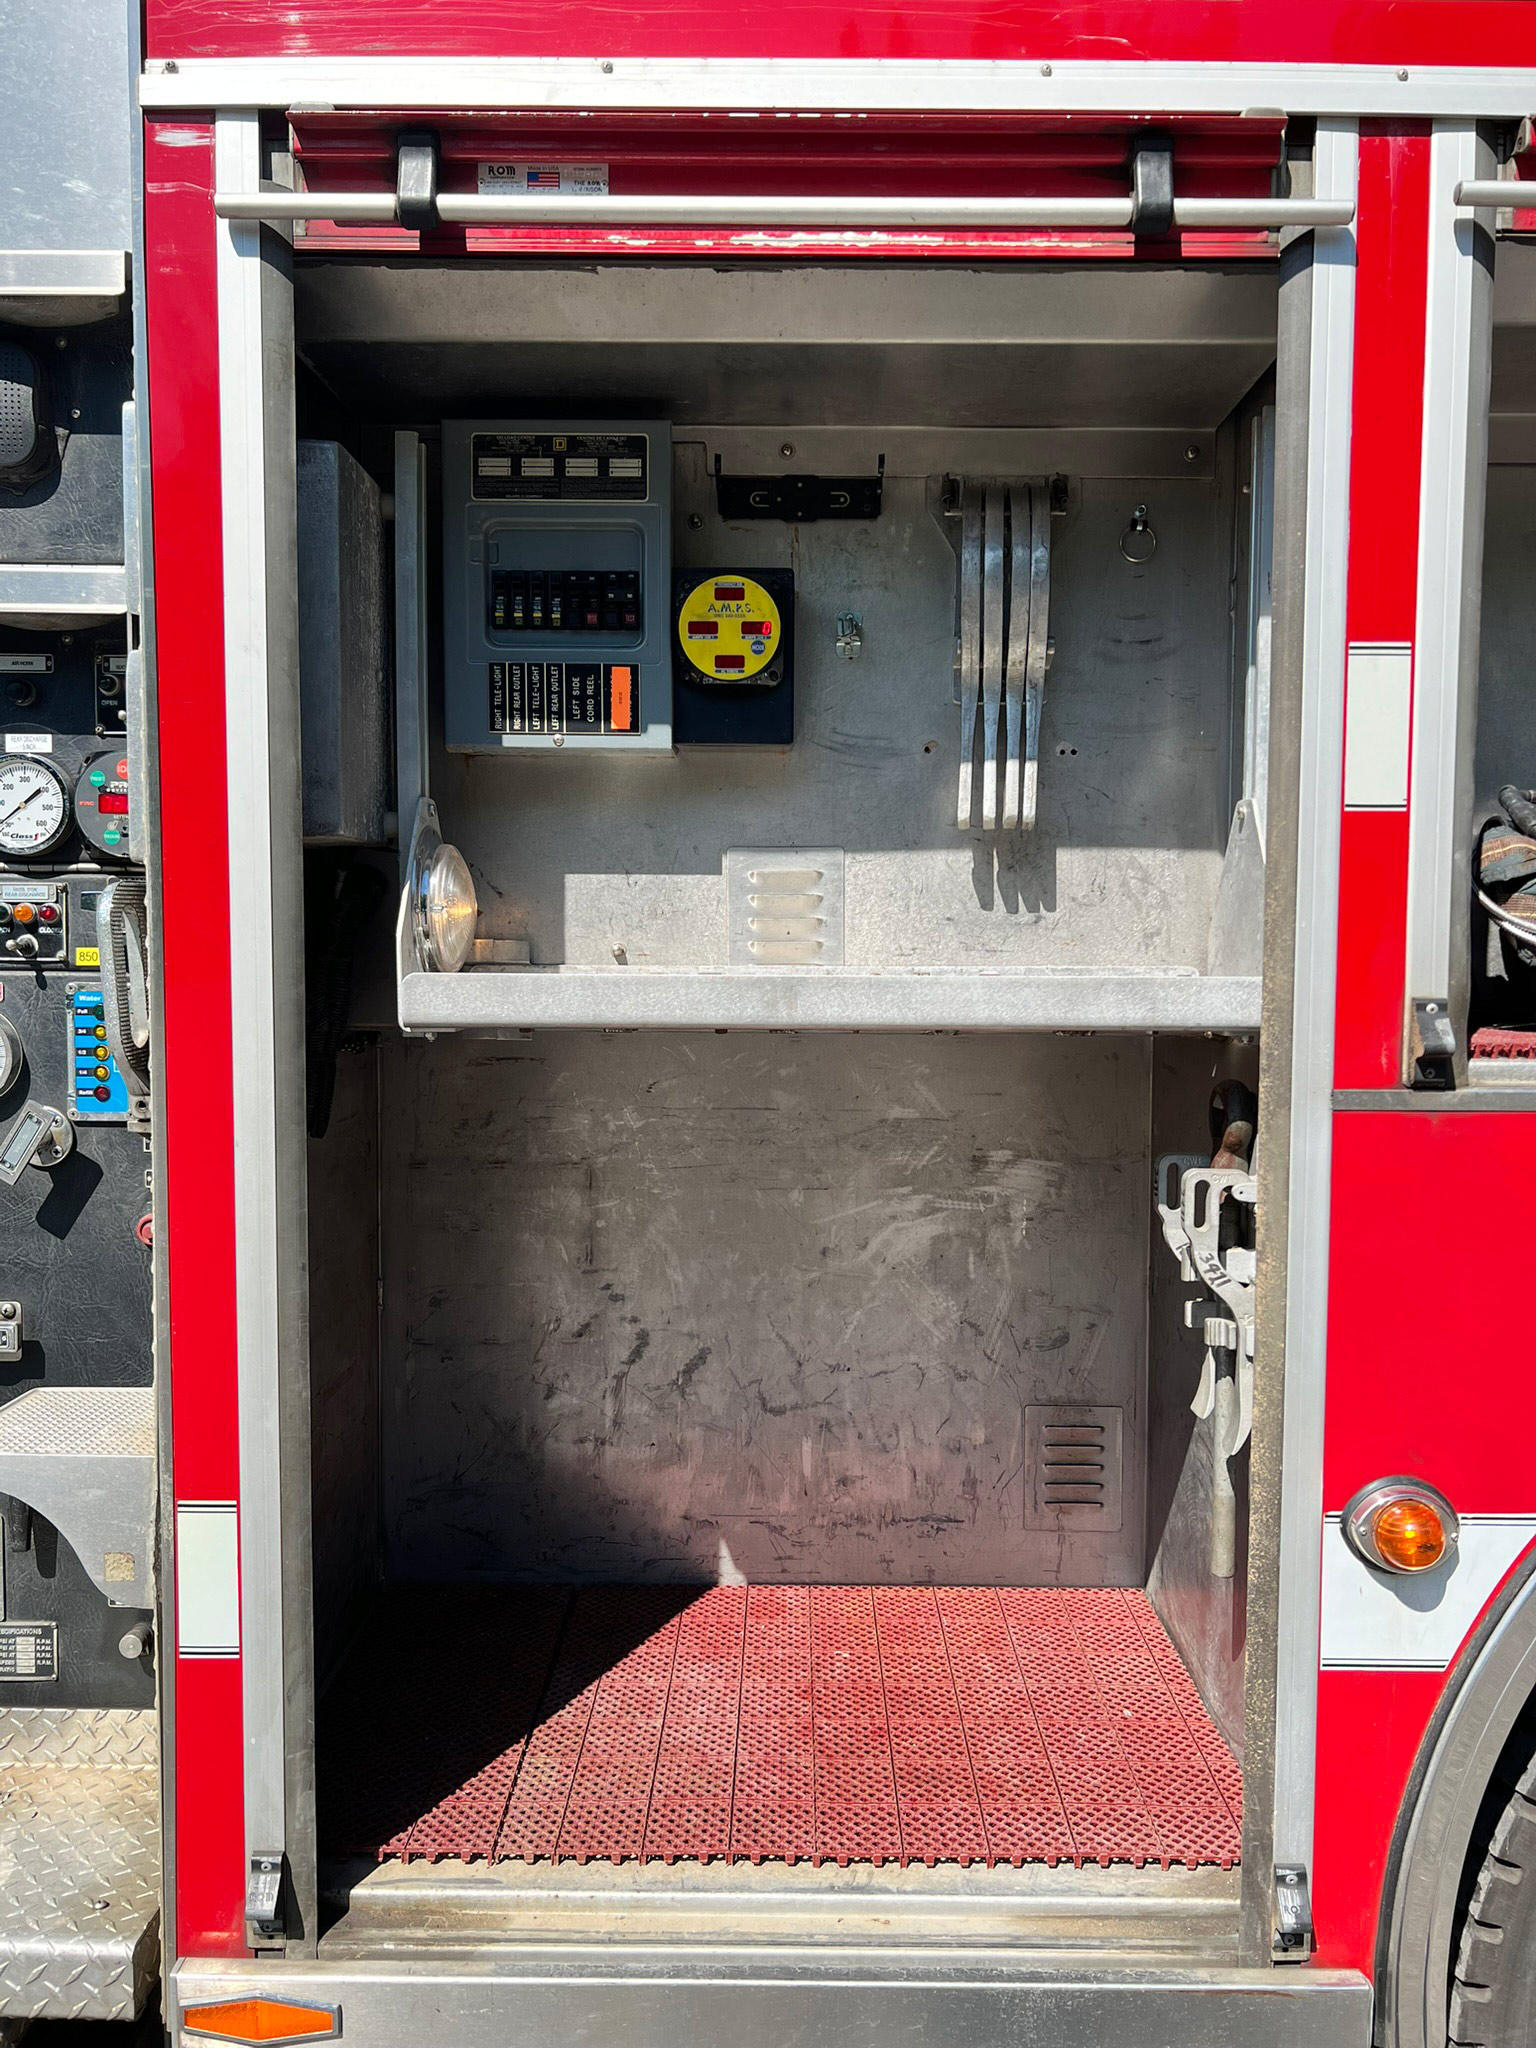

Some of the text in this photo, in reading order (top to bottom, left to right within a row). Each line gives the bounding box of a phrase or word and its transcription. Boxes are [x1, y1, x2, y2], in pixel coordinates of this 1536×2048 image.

[488, 166, 516, 175] ROM
[708, 603, 755, 612] A.M.P.S.
[762, 621, 772, 636] 0
[512, 665, 520, 690] OUTLET
[550, 666, 559, 692] OUTLET
[494, 665, 502, 730] RIGHT TELE-LIGHT
[532, 665, 540, 730] LEFT TELE-LIGHT
[572, 676, 580, 720] LEFT SIDE
[586, 674, 594, 722] CORD REEL
[514, 710, 522, 730] RIGHT
[552, 714, 560, 730] LEFT
[78, 952, 98, 962] 850
